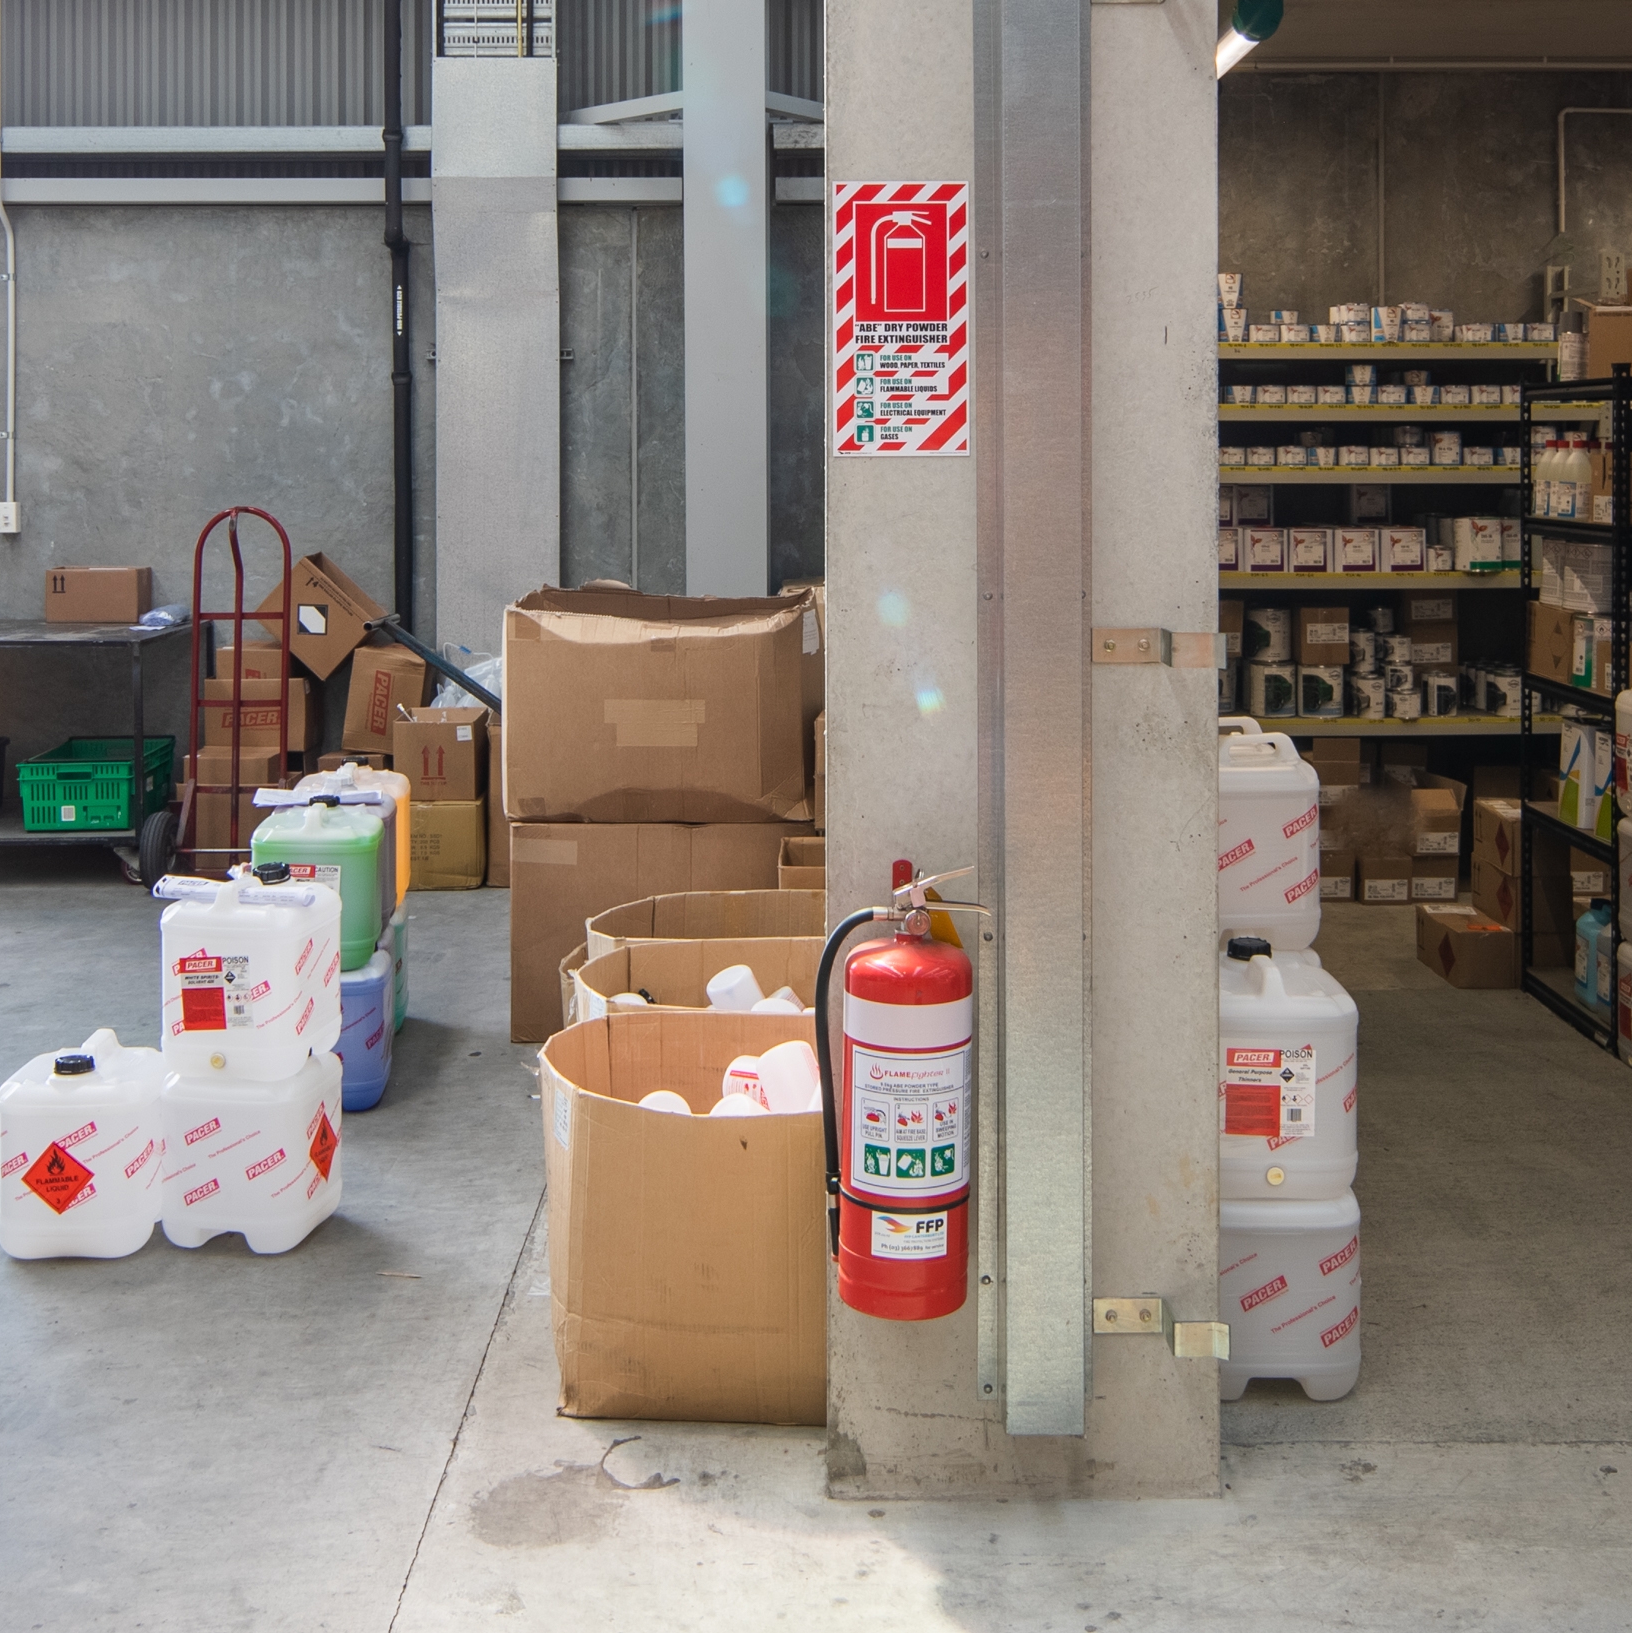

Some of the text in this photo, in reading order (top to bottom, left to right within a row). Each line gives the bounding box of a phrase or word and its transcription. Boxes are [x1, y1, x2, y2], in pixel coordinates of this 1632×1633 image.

[884, 323, 903, 332] DRY
[906, 323, 948, 332] POWDER
[855, 334, 948, 344] FIRE EXTINGUISHER
[920, 361, 946, 369] TEXTILES
[1284, 808, 1317, 837] PACER
[1249, 866, 1282, 887] Professional's
[1286, 873, 1318, 903] PACER
[222, 956, 249, 964] POISON
[1279, 1049, 1313, 1059] POISON
[35, 1176, 79, 1185] FLAMMABLE
[46, 1184, 69, 1193] LIQUID
[916, 1218, 944, 1234] FFP
[1271, 1295, 1336, 1335] The Professional's Choice
